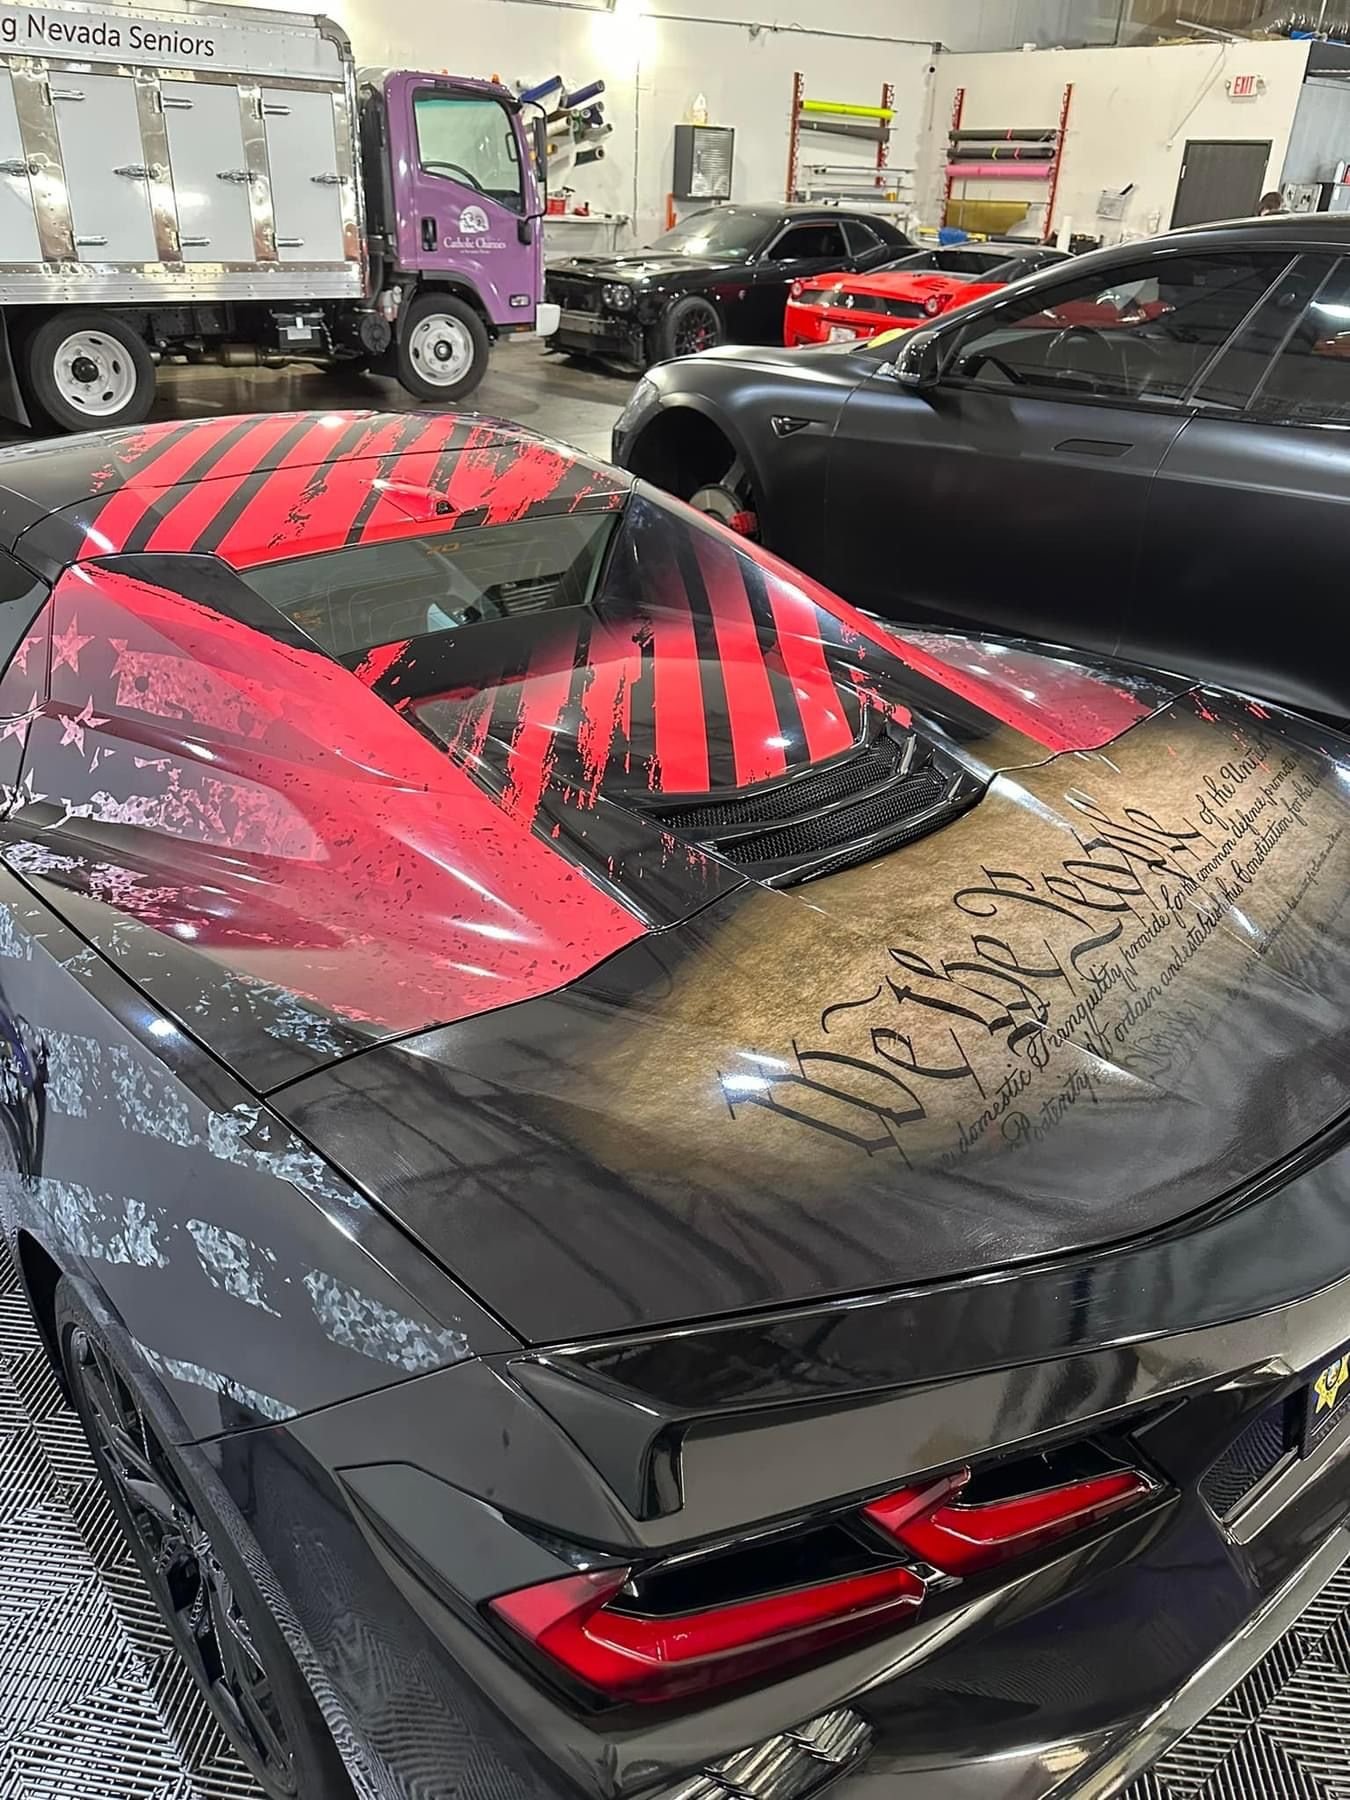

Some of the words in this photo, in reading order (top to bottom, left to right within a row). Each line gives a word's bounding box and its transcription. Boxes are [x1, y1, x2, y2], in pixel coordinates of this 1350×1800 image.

[28, 14, 120, 47] Nevada
[129, 26, 215, 57] Seniors
[1233, 75, 1256, 95] EXIT
[1196, 793, 1230, 832] of
[1202, 775, 1237, 808] the
[953, 795, 1219, 980] People
[1114, 983, 1163, 1042] ordain
[1160, 945, 1187, 987] and
[1230, 818, 1295, 884] Constitution
[885, 932, 1077, 1058] the
[957, 1062, 1032, 1151] domestic
[1199, 835, 1238, 883] common
[717, 984, 988, 1169] We
